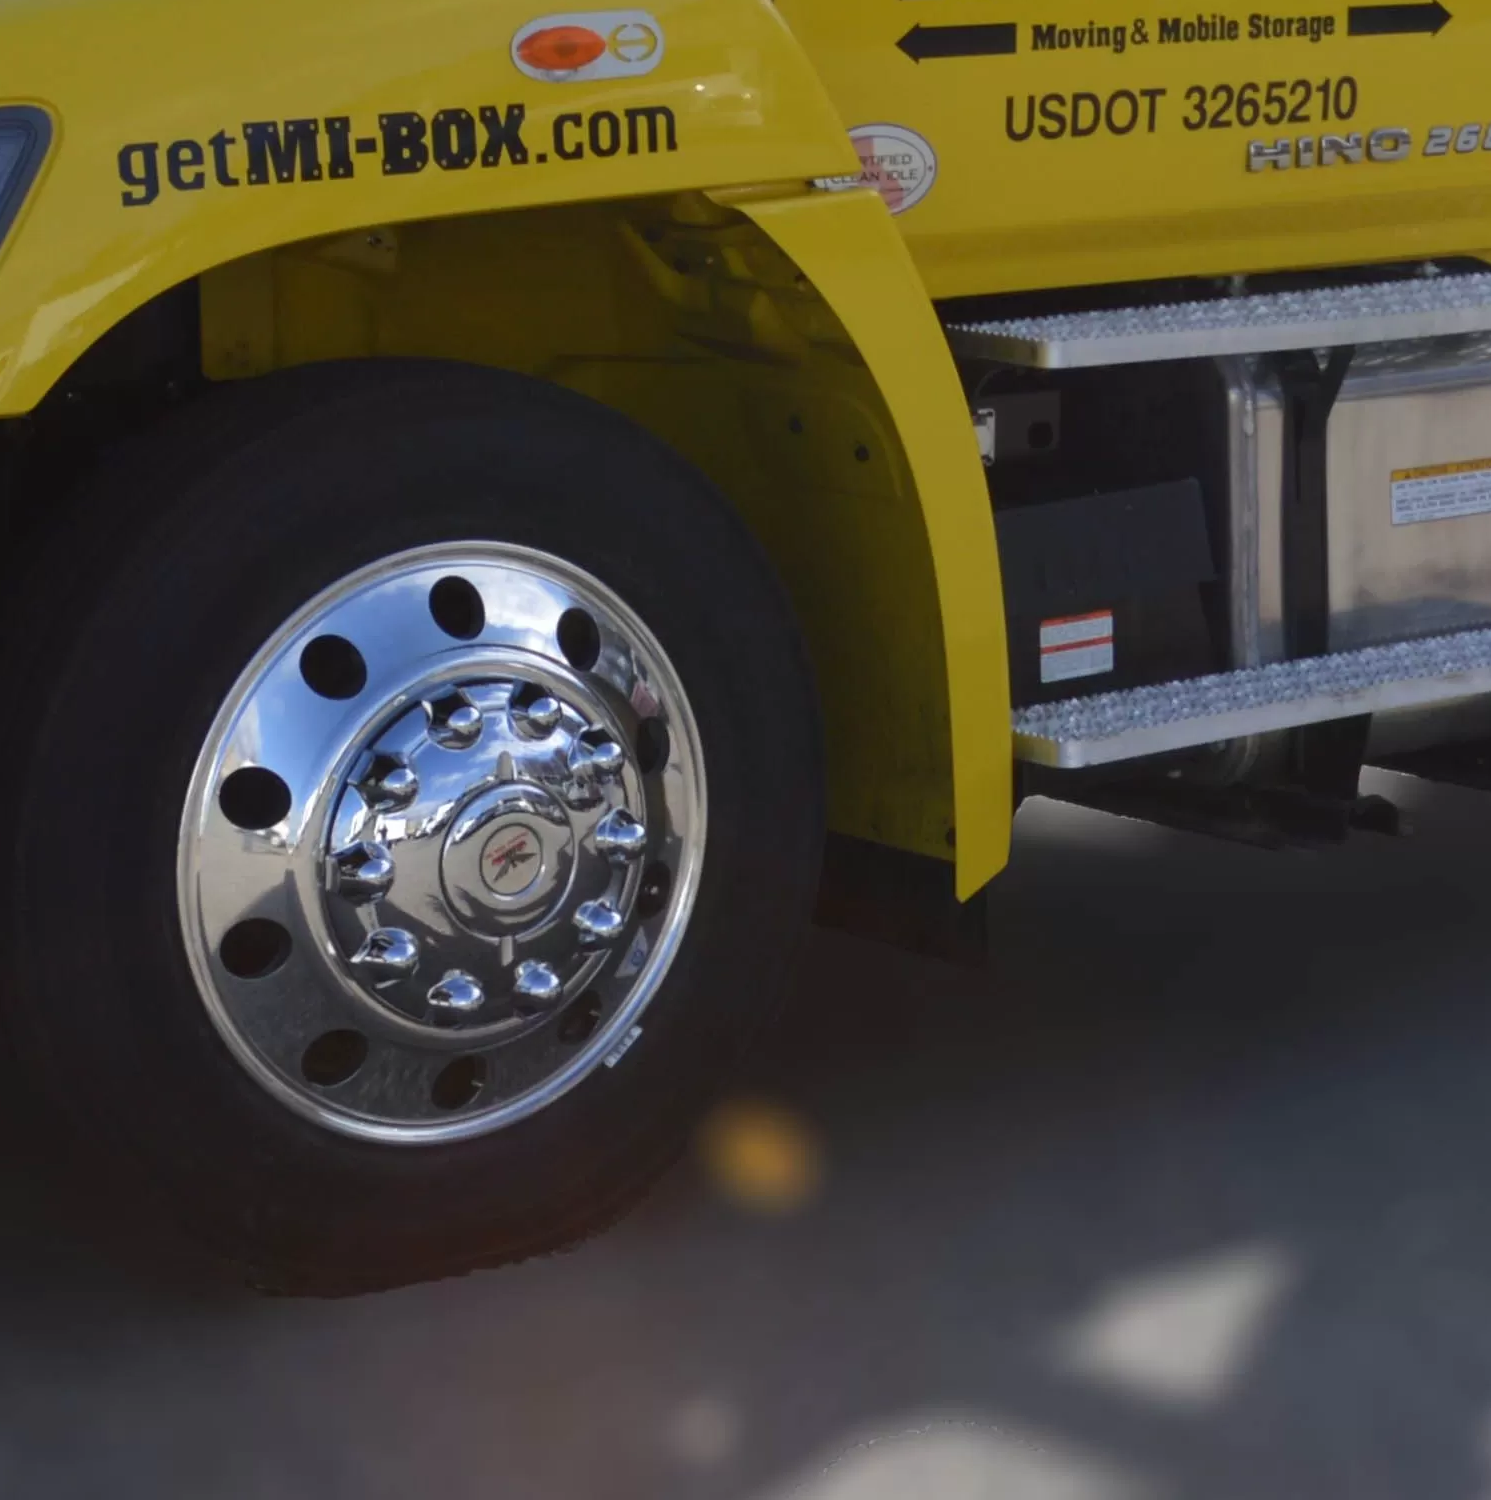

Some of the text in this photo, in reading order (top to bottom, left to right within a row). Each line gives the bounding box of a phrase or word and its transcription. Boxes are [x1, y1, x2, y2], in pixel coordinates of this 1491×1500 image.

[1031, 13, 1335, 54] Moving & Mobile Storage
[1005, 76, 1358, 141] USDOT 3265210
[117, 103, 678, 207] getMI-BOX.com
[859, 154, 912, 166] RTIFIED
[1245, 127, 1411, 172] HINO
[887, 168, 918, 181] IDLE
